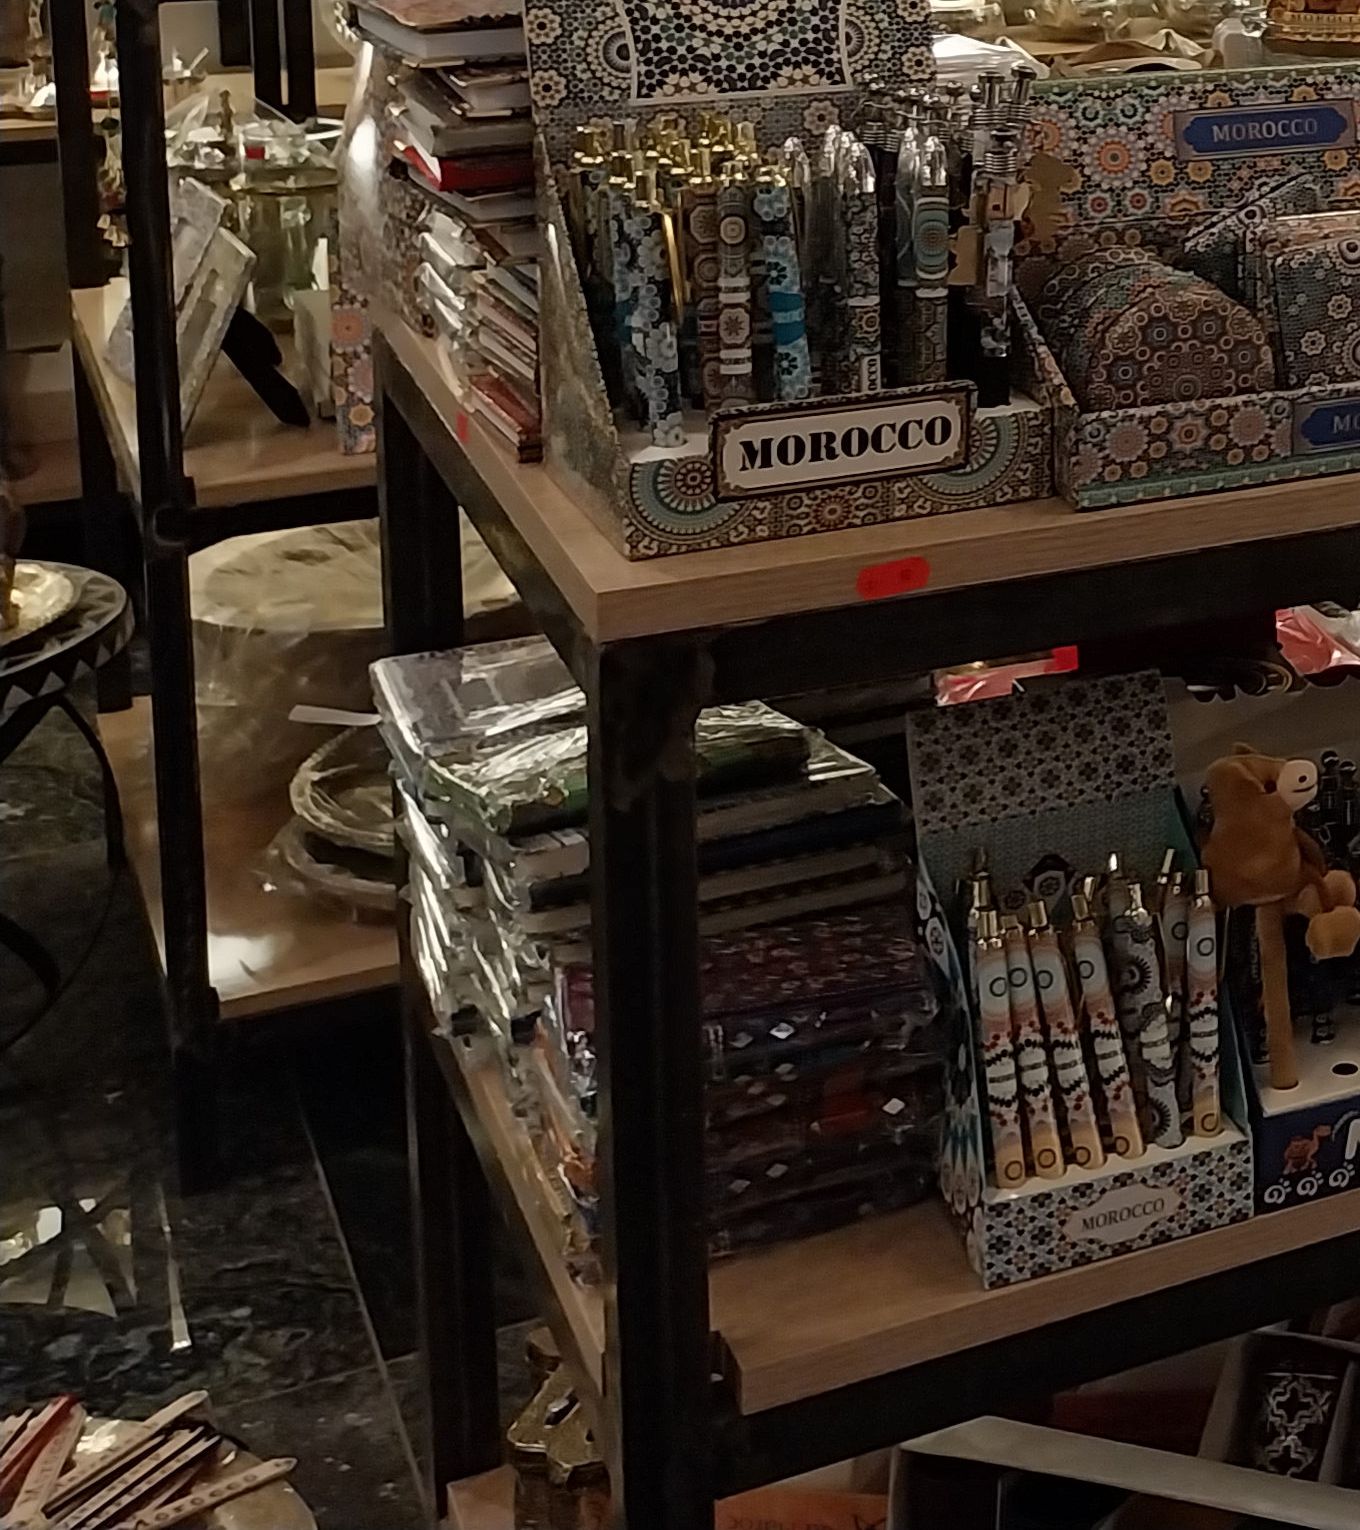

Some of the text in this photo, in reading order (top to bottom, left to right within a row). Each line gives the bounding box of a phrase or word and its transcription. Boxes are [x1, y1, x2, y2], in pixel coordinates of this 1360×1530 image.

[1212, 118, 1318, 143] MOROCCO
[739, 416, 952, 471] MOROCCO
[1082, 1198, 1165, 1231] MOROCCO
